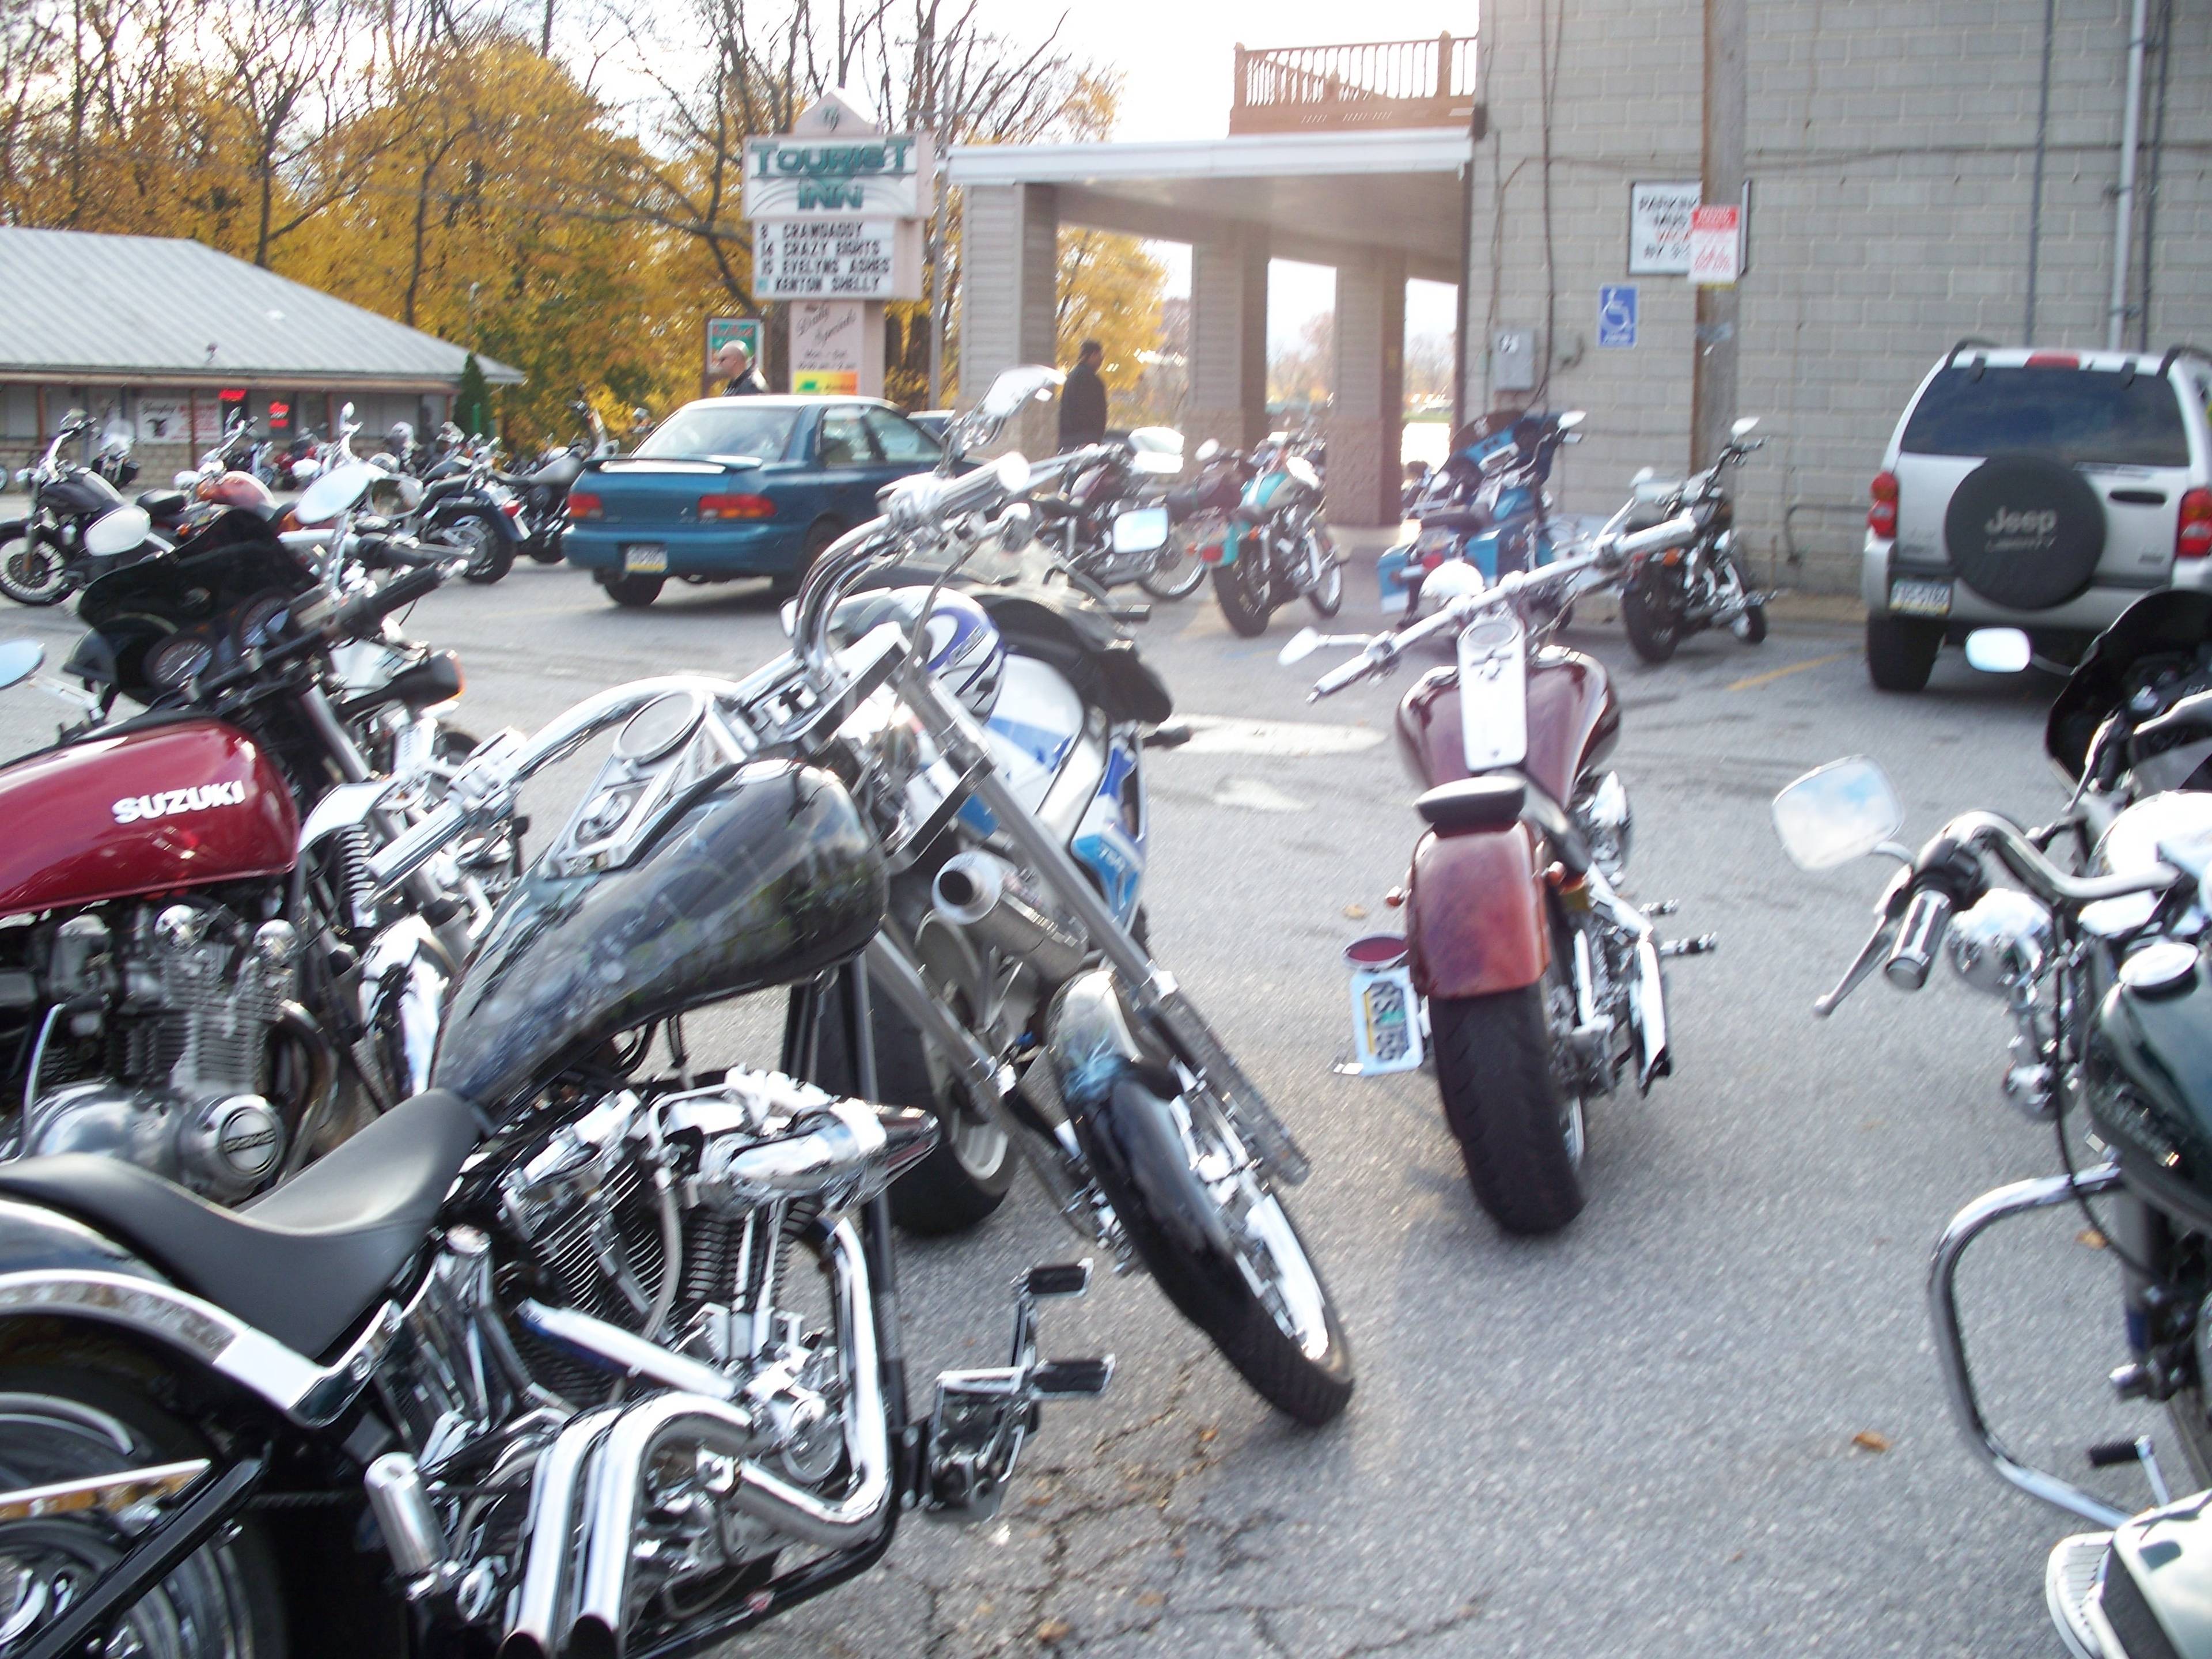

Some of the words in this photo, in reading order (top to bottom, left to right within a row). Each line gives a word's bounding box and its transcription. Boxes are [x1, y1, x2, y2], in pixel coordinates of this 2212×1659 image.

[749, 138, 915, 173] TOURIST
[797, 184, 863, 210] INN
[783, 241, 828, 257] CRAZY
[1984, 505, 2057, 535] Jeep
[112, 779, 245, 824] SUZUKI
